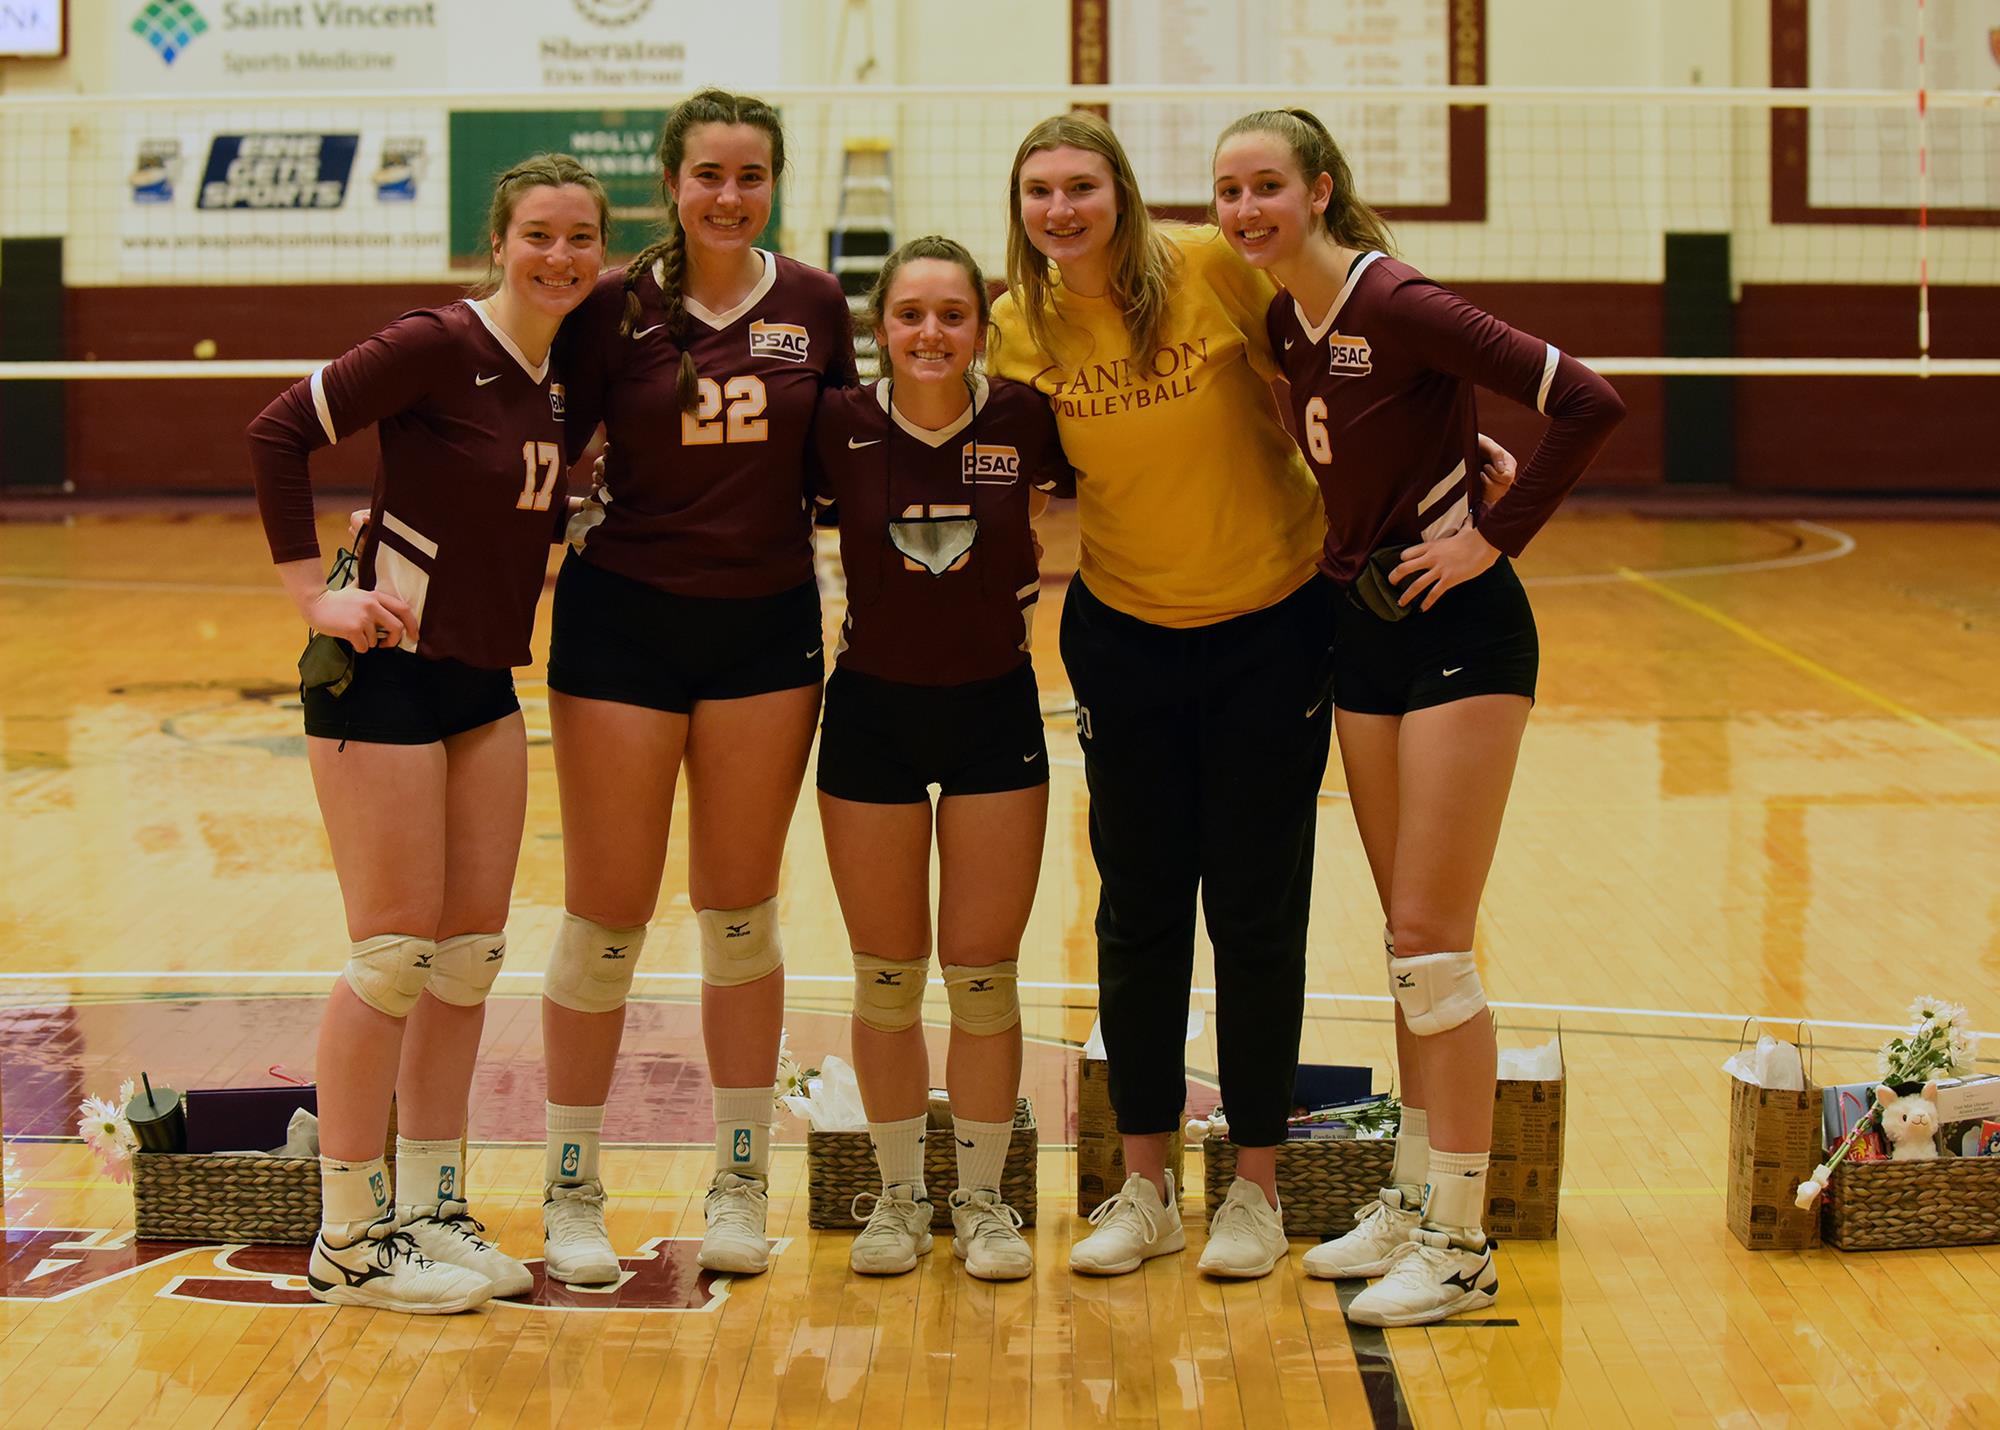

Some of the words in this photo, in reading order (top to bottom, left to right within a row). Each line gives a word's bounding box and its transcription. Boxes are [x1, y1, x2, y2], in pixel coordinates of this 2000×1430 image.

[223, 1, 303, 29] Saint
[314, 1, 437, 29] Vincent
[223, 51, 292, 73] Sports
[296, 50, 396, 71] Medicine
[539, 37, 688, 62] Sheraton
[238, 134, 323, 157] ERIE
[226, 157, 321, 184] GETS
[202, 181, 343, 209] SPORTS
[751, 332, 807, 353] PSAC
[1331, 345, 1370, 365] PSAC
[1052, 374, 1198, 418] VOLLEYBALL
[681, 374, 769, 446] 22
[1305, 396, 1333, 465] 6
[516, 440, 560, 512] 17
[964, 455, 1017, 473] PSAC
